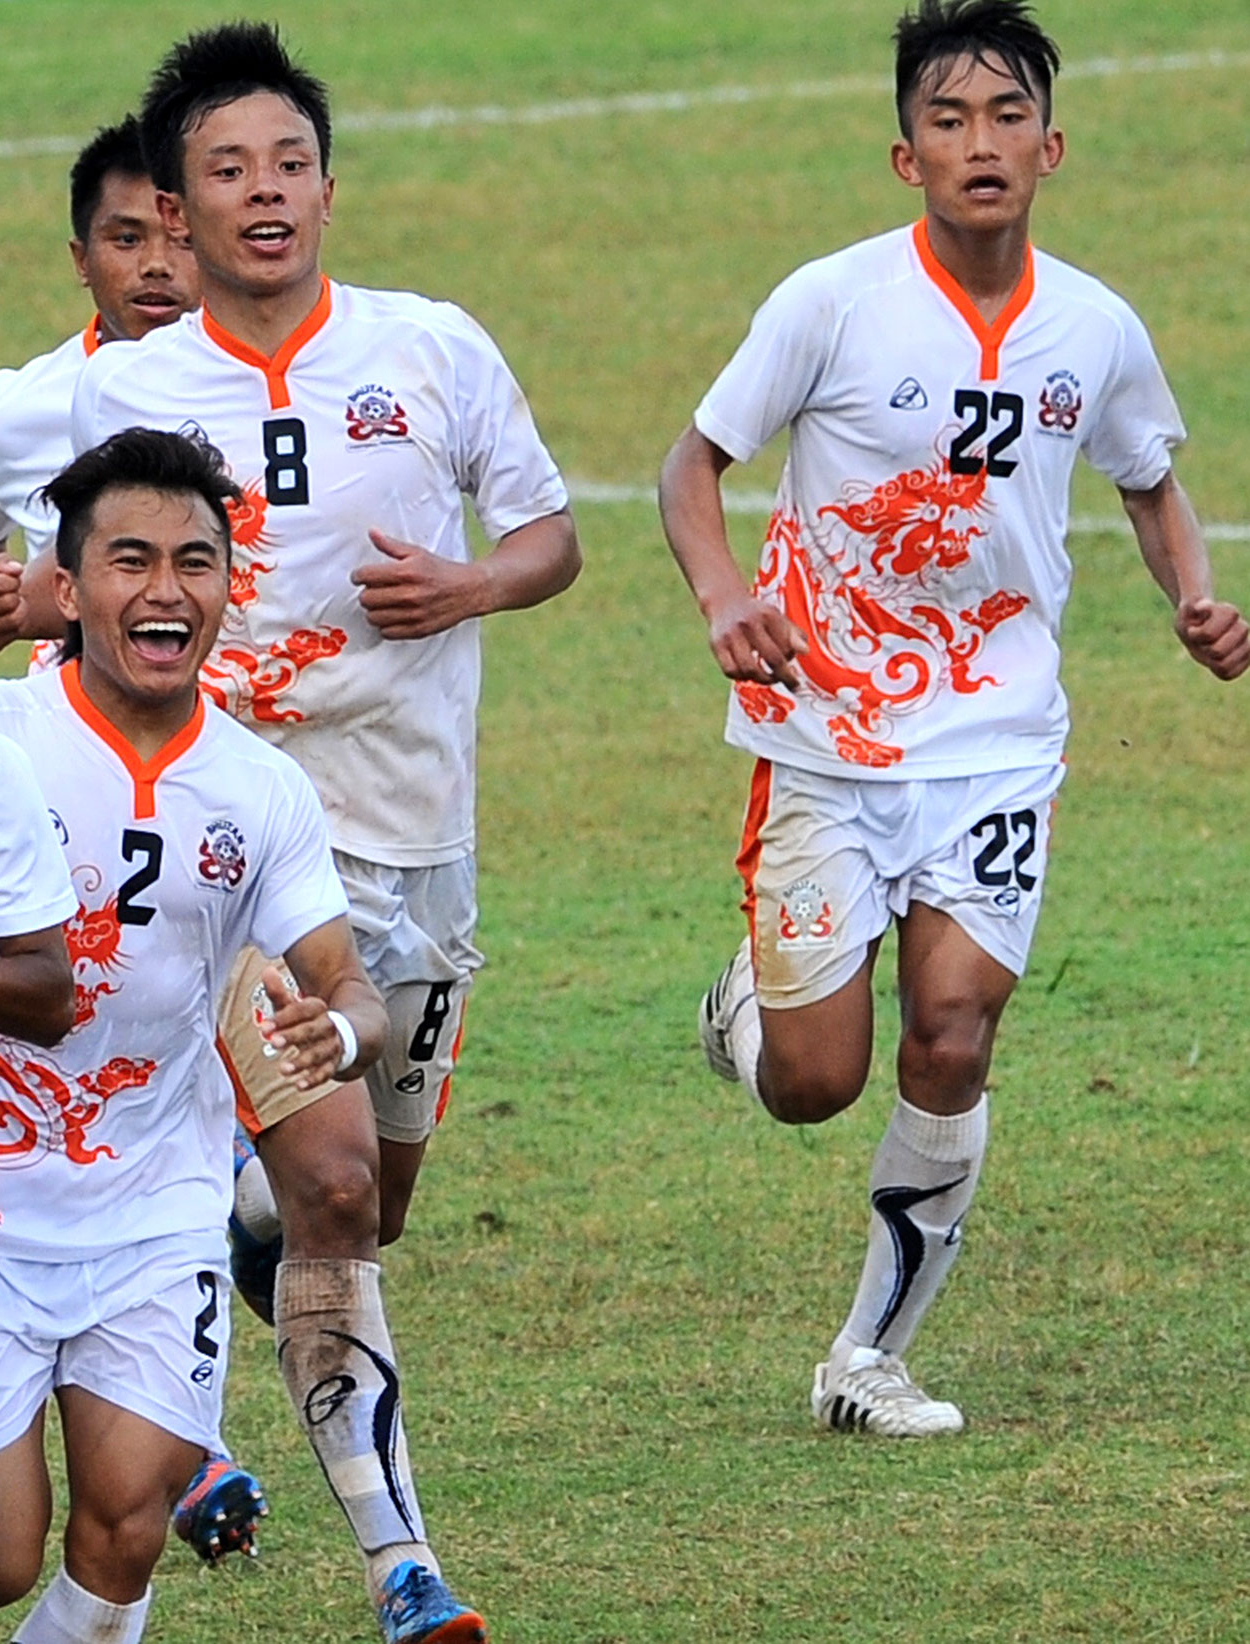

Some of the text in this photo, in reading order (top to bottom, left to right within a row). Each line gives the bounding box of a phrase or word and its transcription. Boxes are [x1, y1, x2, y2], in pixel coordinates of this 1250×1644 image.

[347, 384, 395, 402] BHUTAN
[950, 389, 1024, 478] 22
[262, 418, 309, 506] 8
[117, 828, 163, 926] 2
[969, 809, 1038, 892] 22
[408, 981, 454, 1062] 8
[194, 1270, 220, 1359] 2
